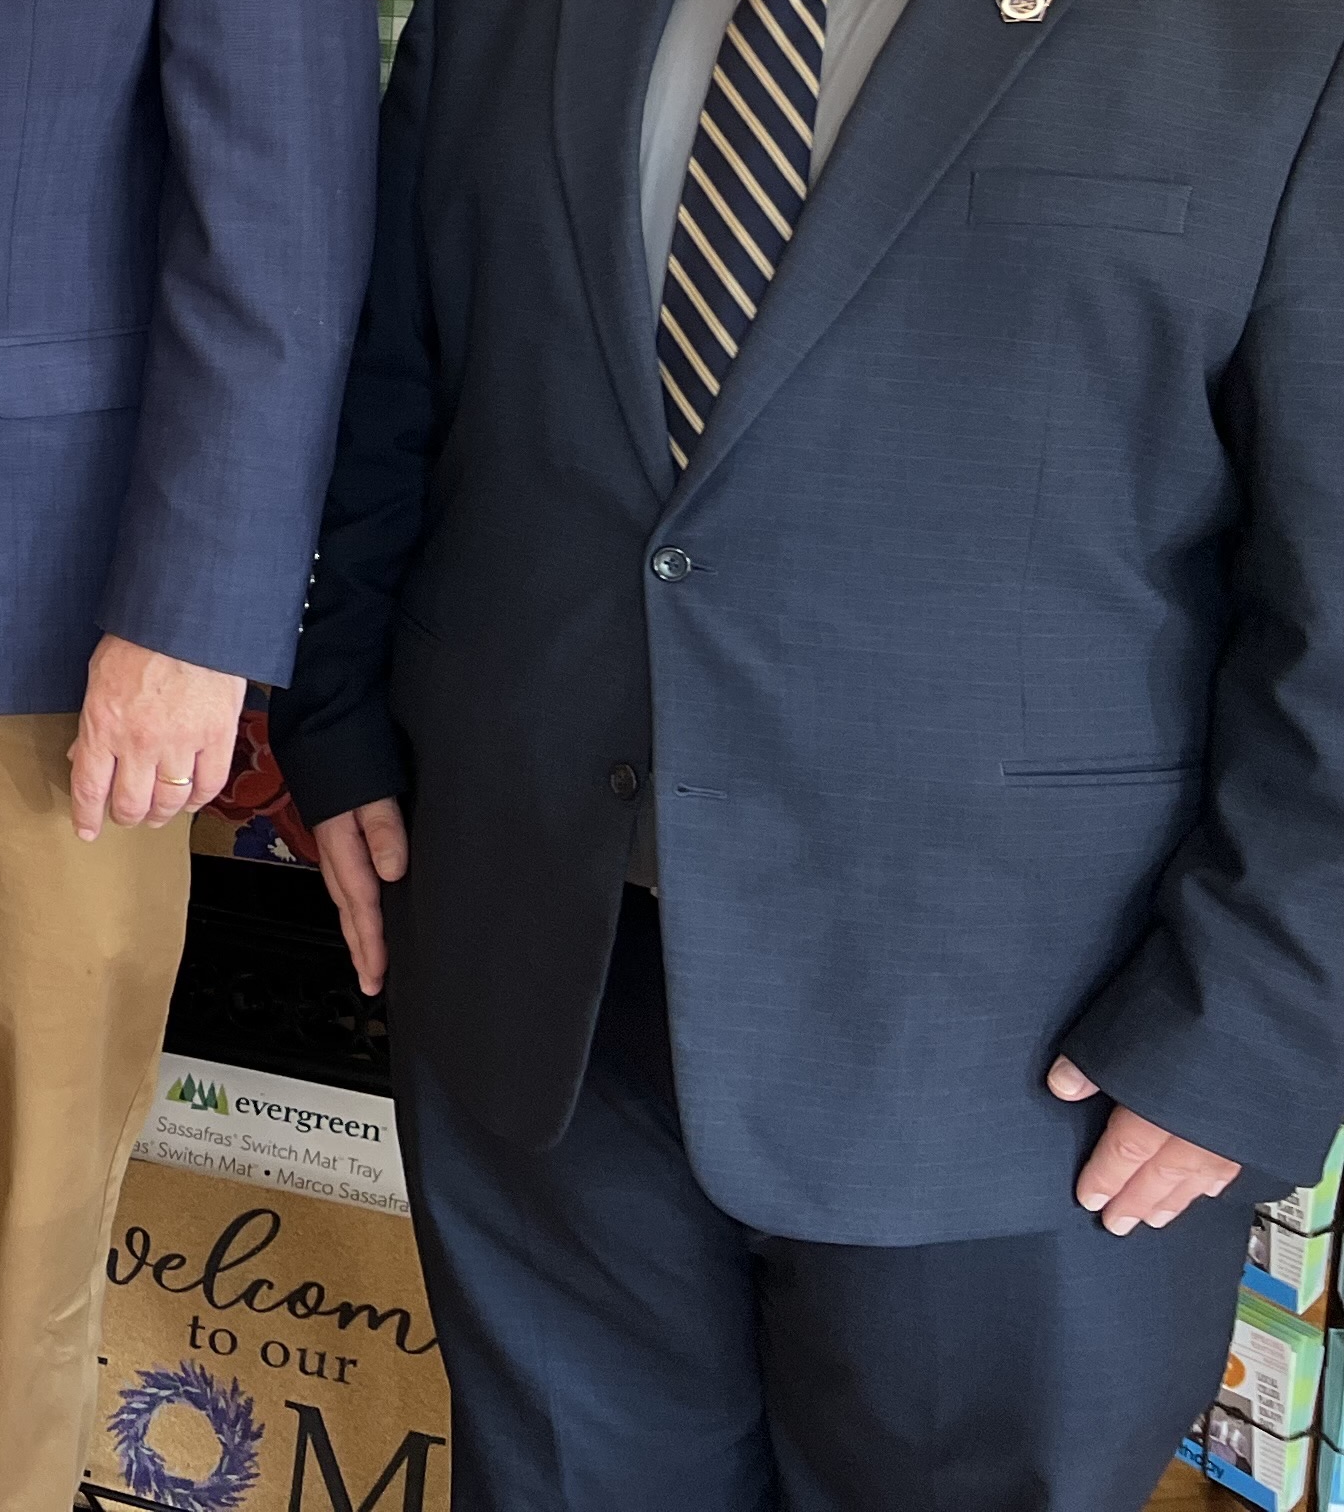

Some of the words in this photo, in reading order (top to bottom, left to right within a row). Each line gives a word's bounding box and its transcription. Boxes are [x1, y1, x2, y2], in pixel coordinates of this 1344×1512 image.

[234, 1094, 382, 1143] evergreen
[157, 1140, 215, 1170] Switch
[218, 1155, 253, 1177] Mat
[277, 1168, 335, 1197] Marco
[241, 1134, 299, 1161] Switch
[302, 1145, 338, 1169] Mat
[347, 1156, 384, 1184] Tray
[187, 1314, 239, 1356] to
[260, 1339, 358, 1386] our
